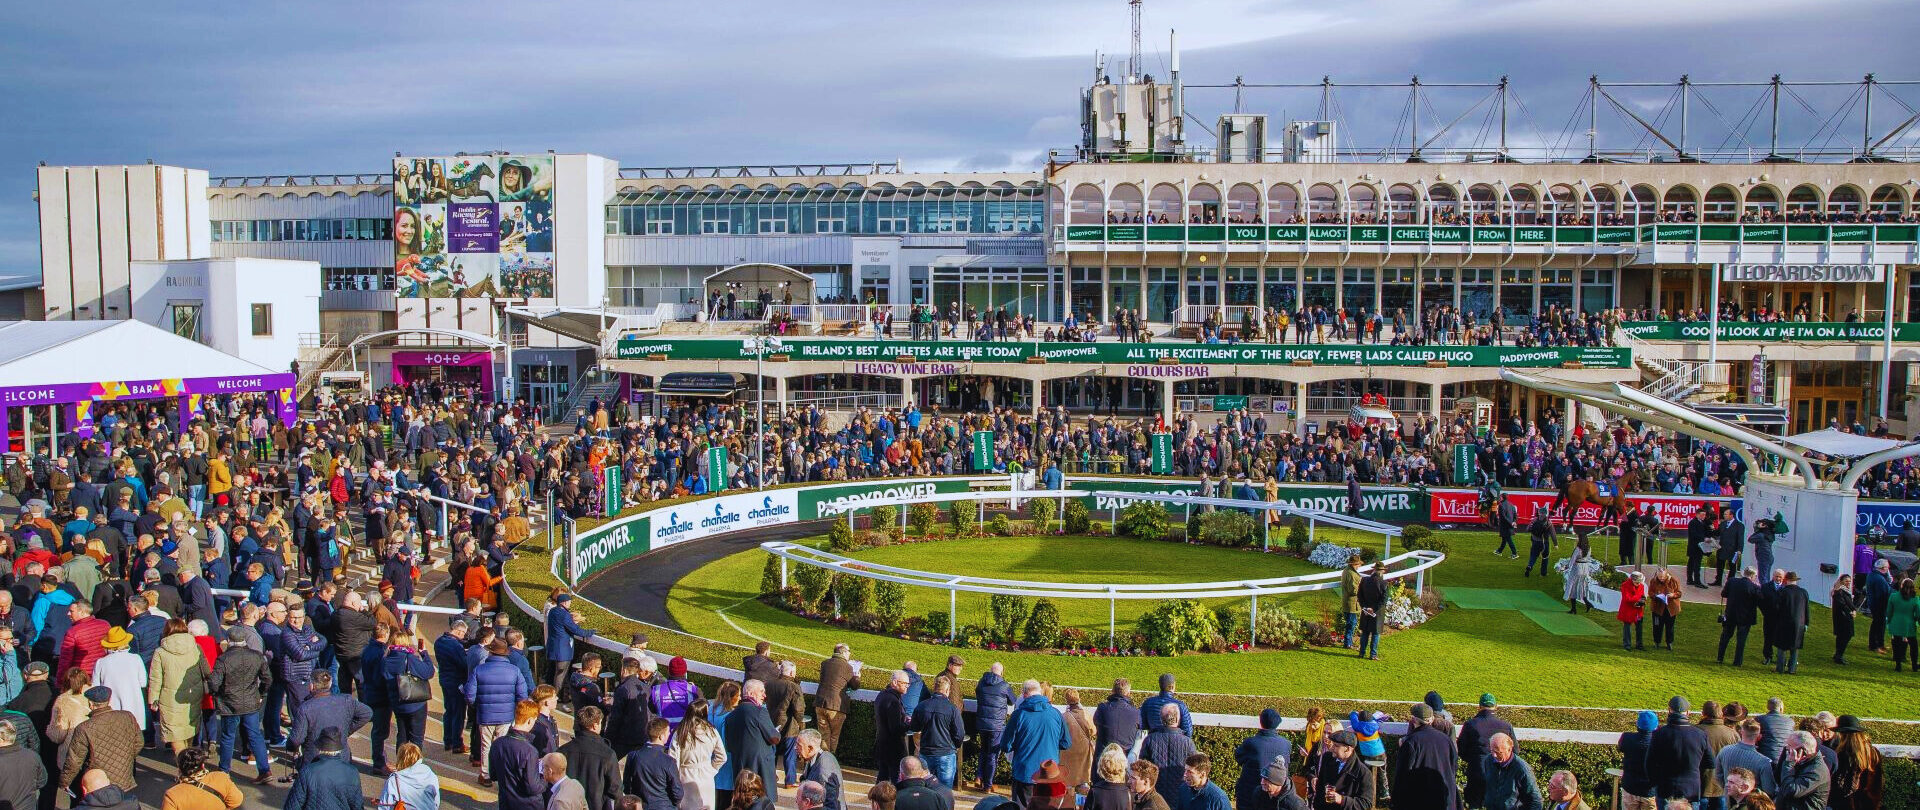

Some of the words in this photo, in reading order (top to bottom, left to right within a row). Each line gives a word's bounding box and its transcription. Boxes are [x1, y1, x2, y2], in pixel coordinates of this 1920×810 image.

[1235, 229, 1258, 238] YOU
[1276, 229, 1298, 238] CAN
[1309, 229, 1347, 238] ALMOST
[1361, 229, 1378, 239] SEE
[1396, 229, 1461, 239] CHELTENHAM
[1478, 230, 1506, 239] FROM
[1520, 230, 1546, 240] HERE.
[1658, 229, 1694, 237] PADDYPOWER
[1743, 229, 1780, 237] PADDYPOWER
[1729, 265, 1875, 281] LEOPARDSTOWN
[1681, 326, 1726, 336] OOOH
[1728, 327, 1760, 336] LOOK
[1763, 327, 1777, 337] AT
[1780, 327, 1795, 337] ME
[1797, 327, 1814, 337] I'M
[1816, 327, 1835, 337] ON
[1837, 327, 1846, 337] A
[1849, 328, 1901, 337] BALCOY
[619, 343, 673, 356] PADDYPOWER
[802, 345, 853, 356] IRELAND'S
[856, 345, 879, 356] BEST
[882, 346, 931, 356] ATHLETES
[934, 346, 954, 356] ARE
[957, 346, 983, 357] HERE
[986, 347, 1022, 357] TODAY
[1039, 347, 1098, 358] PADDYPOWER
[1126, 348, 1145, 358] ALL
[1149, 348, 1169, 358] THE
[1172, 349, 1239, 359] EXCITEMENT
[1241, 349, 1257, 359] OF
[1260, 349, 1281, 360] THE
[1285, 350, 1324, 361] RUGBY,
[1327, 350, 1362, 360] FEWER
[1366, 350, 1393, 361] LADS
[1396, 350, 1436, 361] CALLED
[1439, 351, 1473, 361] HUGO
[424, 353, 461, 364] tote
[1500, 351, 1559, 363] PADDYPOWER
[855, 363, 899, 375] LEGACY
[900, 363, 929, 375] WINE
[931, 363, 955, 375] BAR
[1127, 365, 1183, 377] COLOURS
[1184, 366, 1209, 377] BAR
[132, 384, 153, 394] BAR
[217, 379, 261, 389] WELCOME
[5, 389, 56, 402] ELCOME
[748, 505, 790, 520] chanelle
[701, 512, 740, 528] chanelle
[756, 517, 780, 526] PHARMA
[657, 520, 693, 538] chanelle
[708, 525, 731, 534] PHARMA
